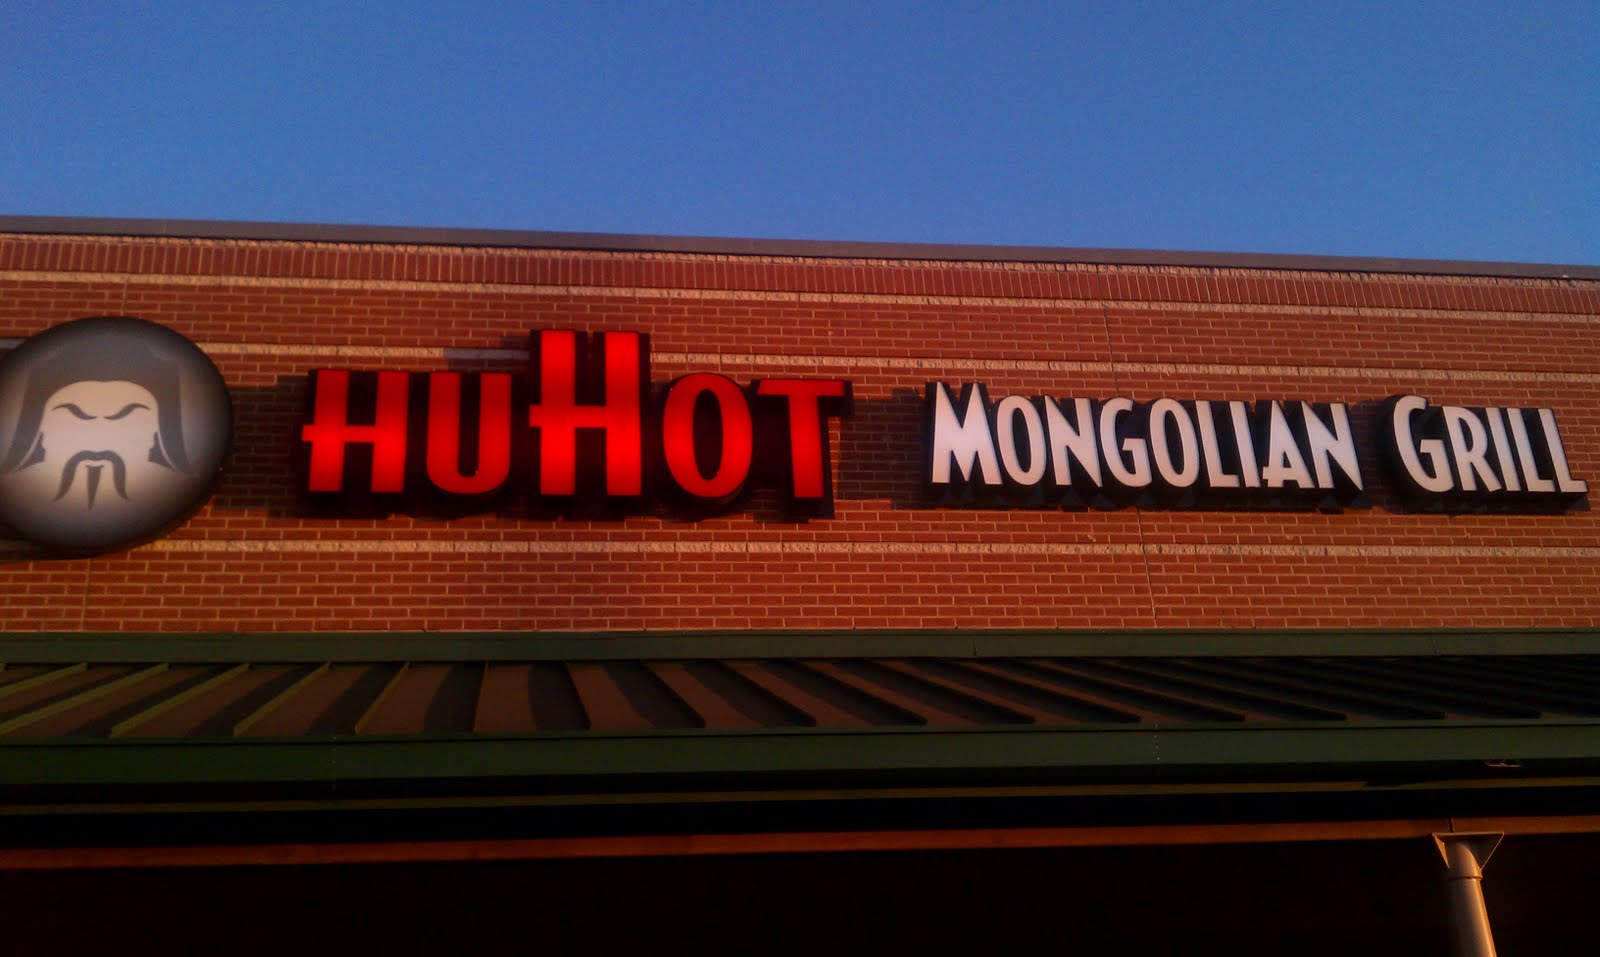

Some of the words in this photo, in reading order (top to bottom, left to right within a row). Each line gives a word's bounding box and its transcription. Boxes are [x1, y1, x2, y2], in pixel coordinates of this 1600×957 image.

[302, 329, 846, 499] HUHOT
[931, 382, 1363, 491] MONGOLIAN
[1393, 395, 1588, 493] GRILL
